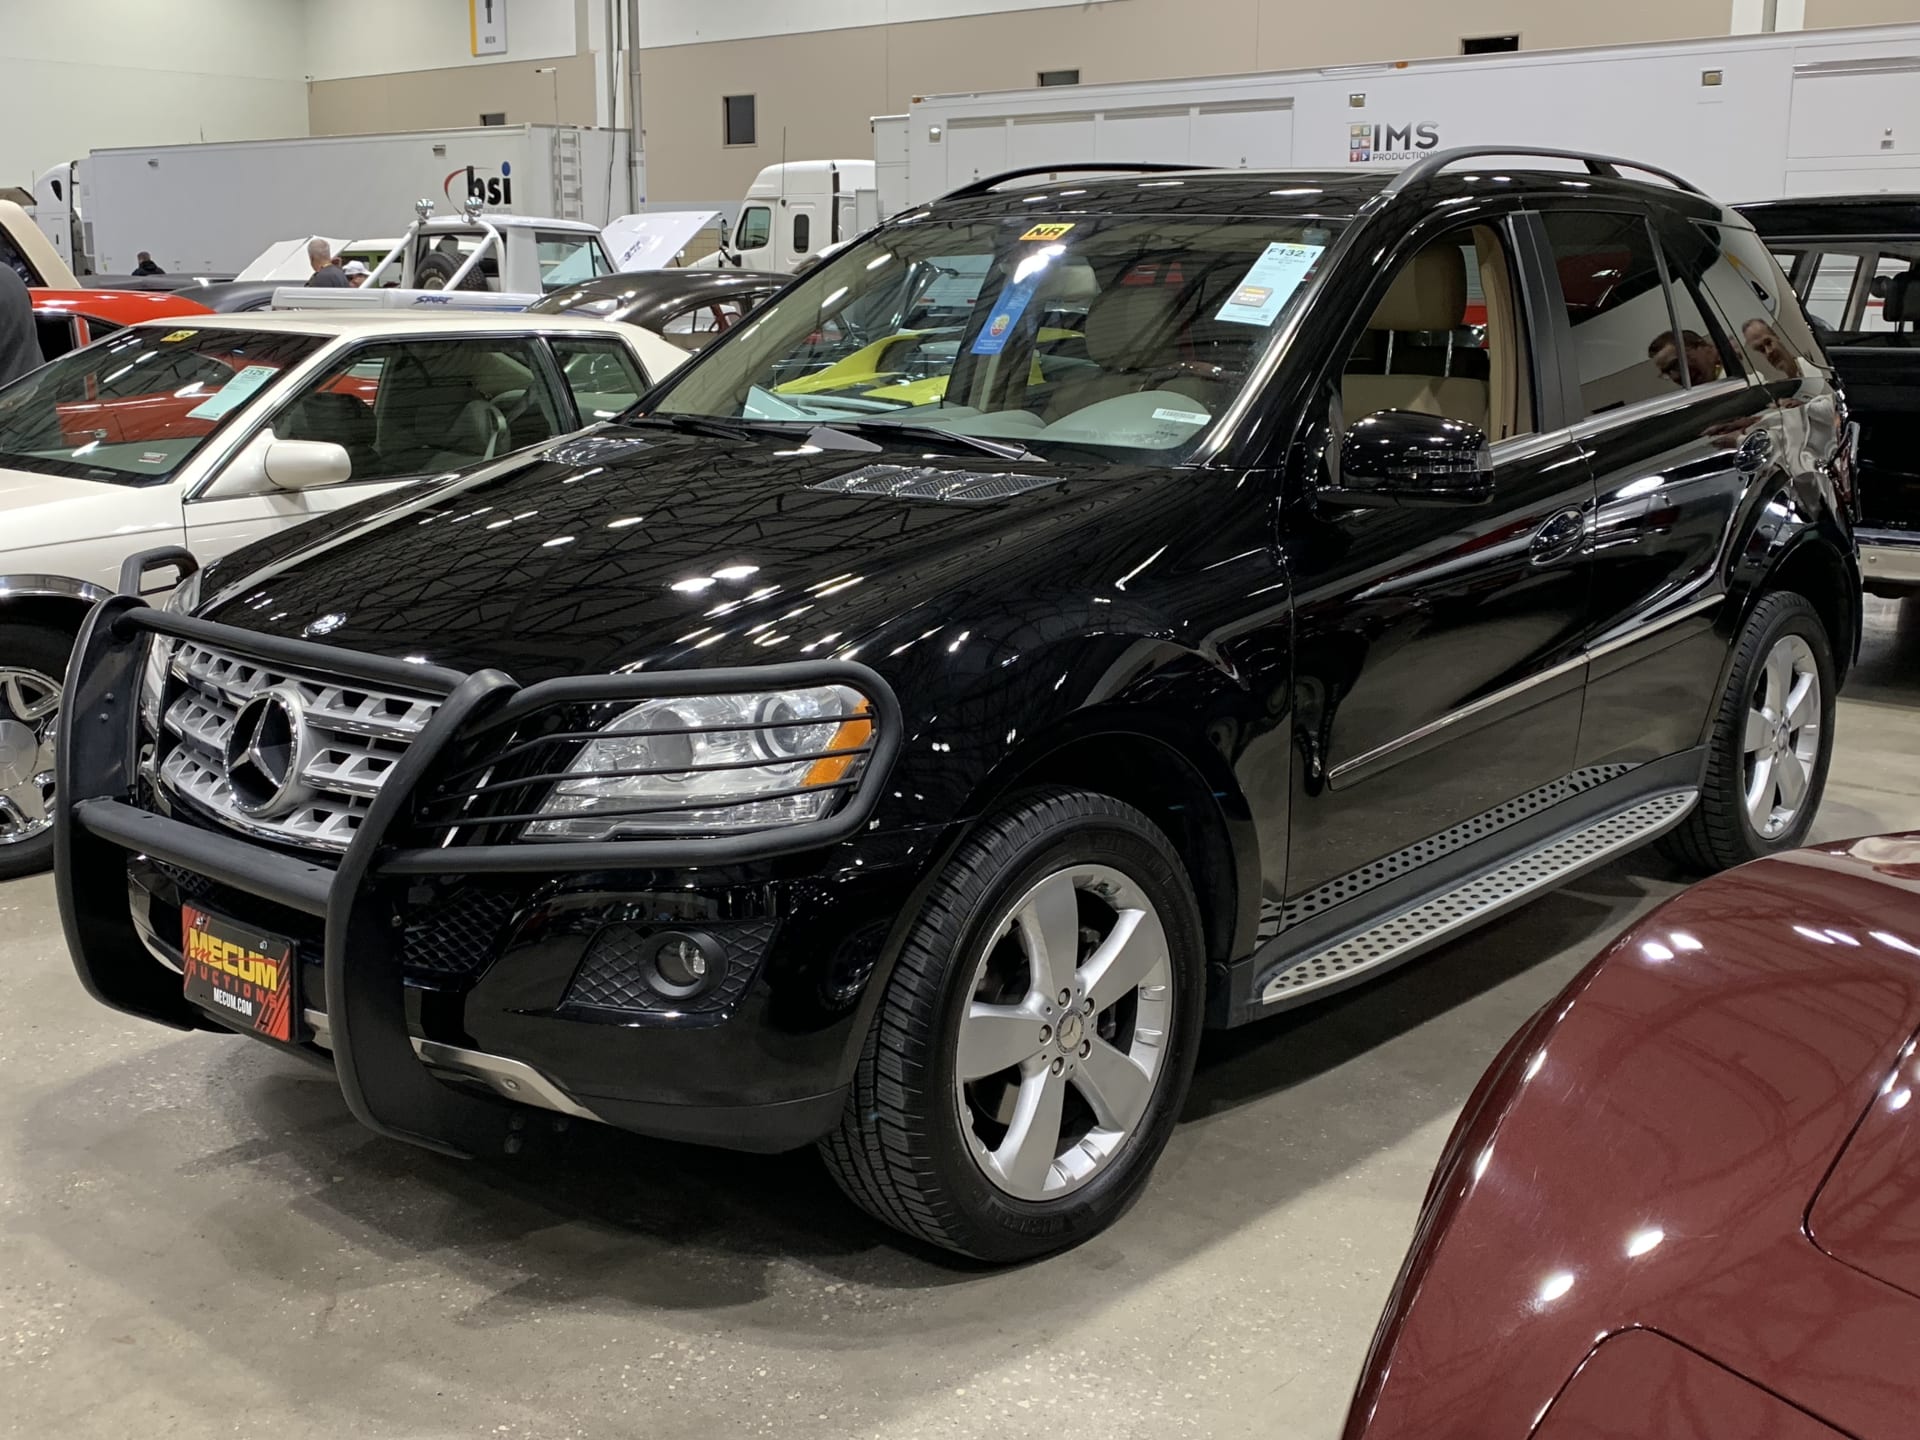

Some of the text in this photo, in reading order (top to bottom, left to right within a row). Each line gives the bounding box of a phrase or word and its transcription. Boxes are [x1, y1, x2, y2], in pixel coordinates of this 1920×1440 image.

[1374, 121, 1439, 152] IMS
[1373, 151, 1438, 160] PRODUCTION
[466, 161, 511, 206] bsi
[1027, 227, 1065, 236] NR
[1267, 247, 1316, 259] F132.1
[189, 927, 277, 992] MECUM
[189, 960, 277, 1009] AUCTIONS
[213, 986, 252, 1017] MECUM.COM
